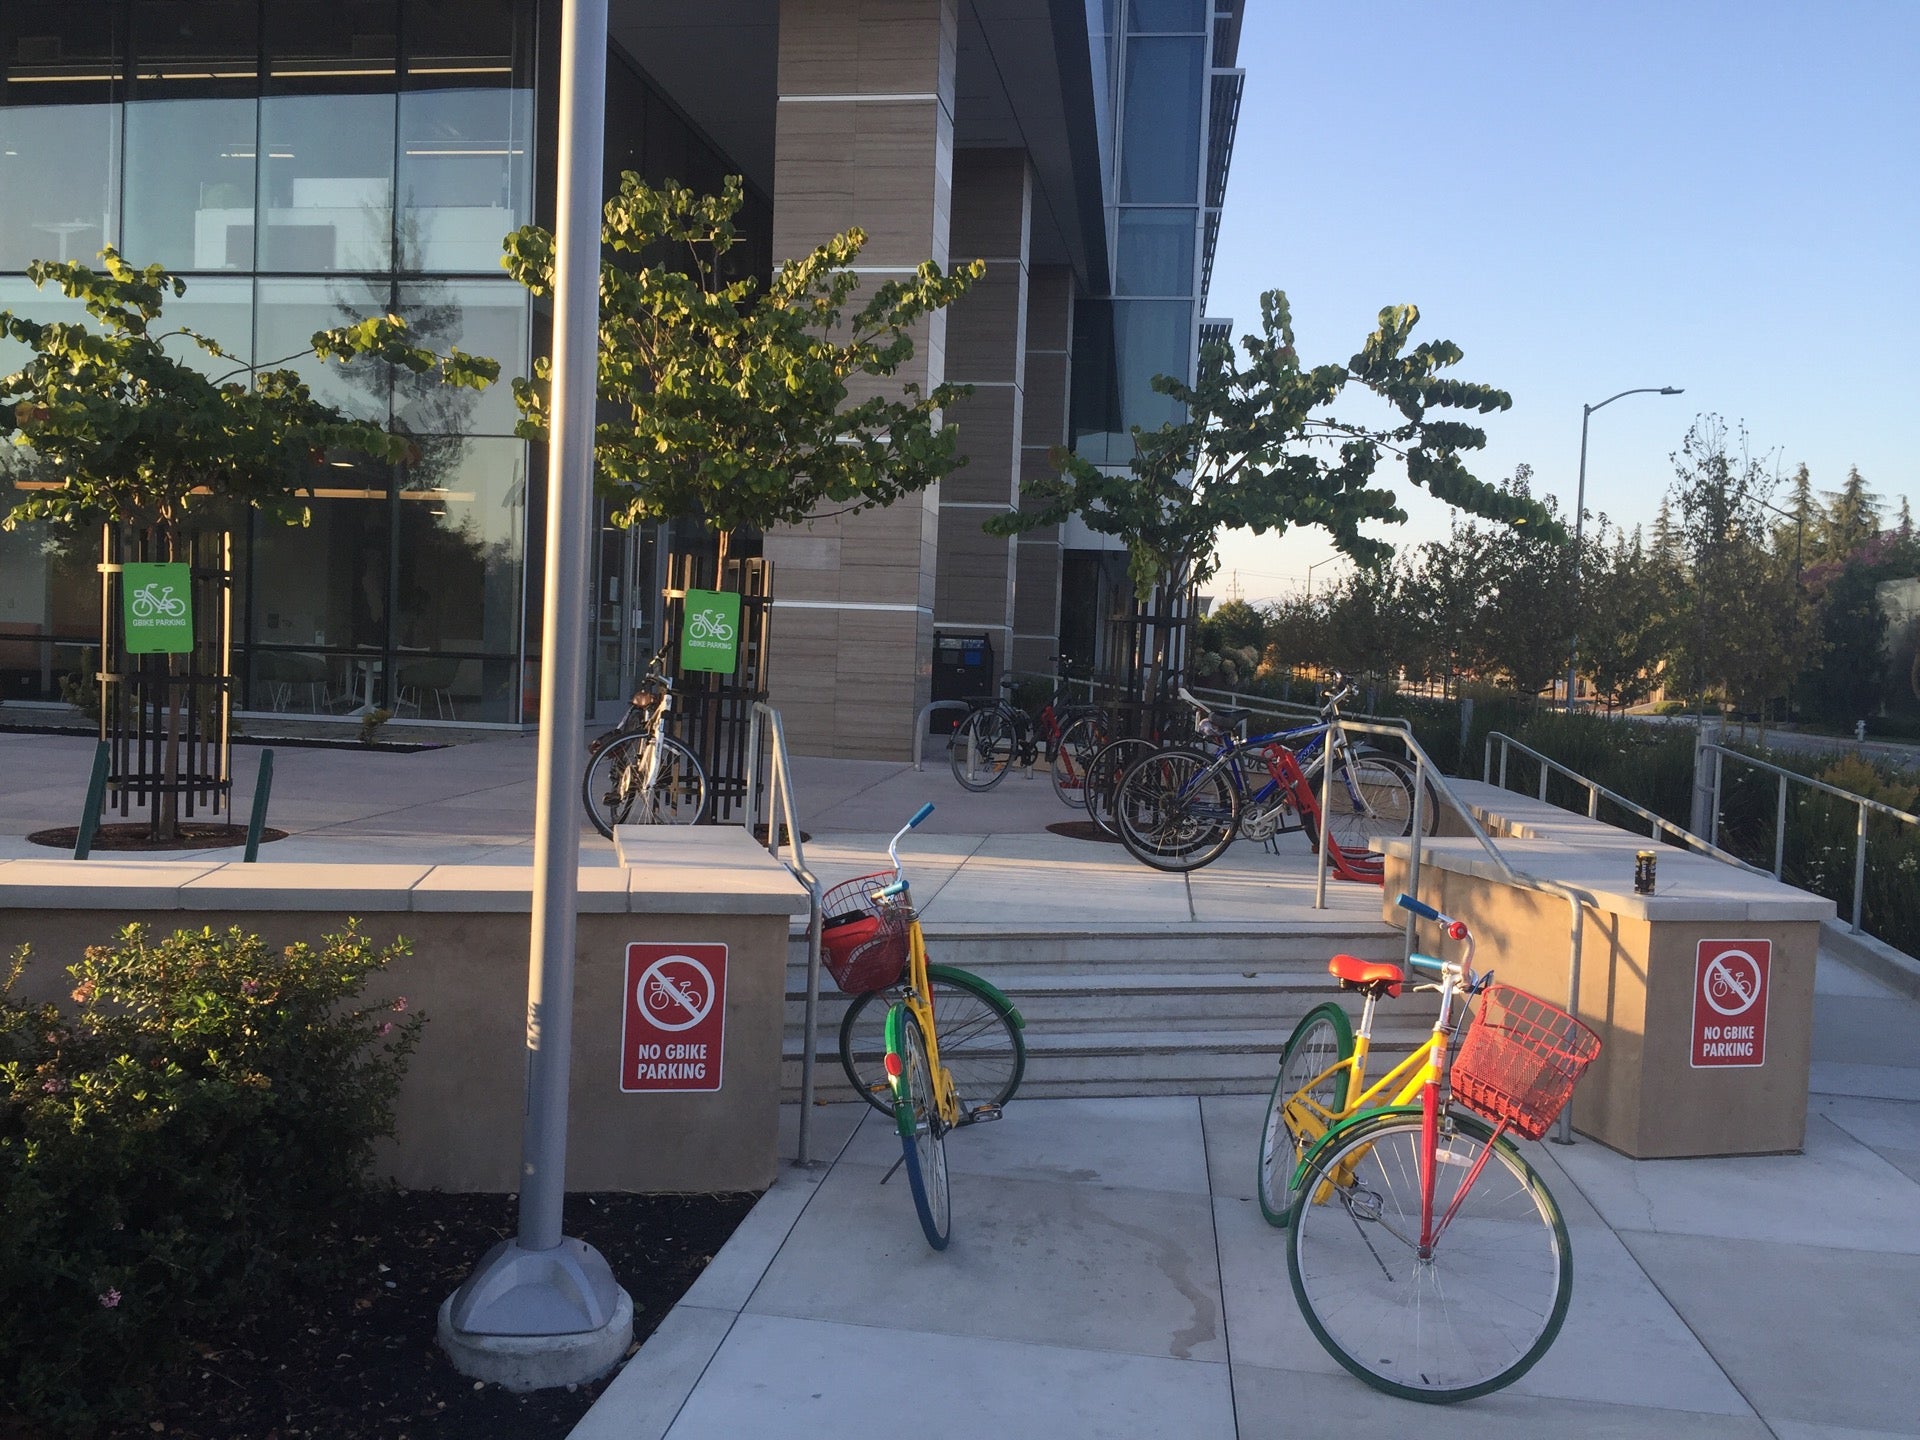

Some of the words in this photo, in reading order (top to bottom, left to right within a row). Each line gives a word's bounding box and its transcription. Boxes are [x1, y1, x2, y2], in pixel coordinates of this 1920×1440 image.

[155, 618, 186, 626] PARKING
[689, 640, 706, 648] GBIKE
[706, 641, 732, 650] PARKING
[1704, 1026, 1721, 1040] NO
[1723, 1026, 1755, 1040] GBIKE
[638, 1044, 661, 1060] NO
[665, 1044, 707, 1060] GBIKE
[1703, 1042, 1753, 1057] PARKING
[637, 1063, 706, 1080] PARKING
